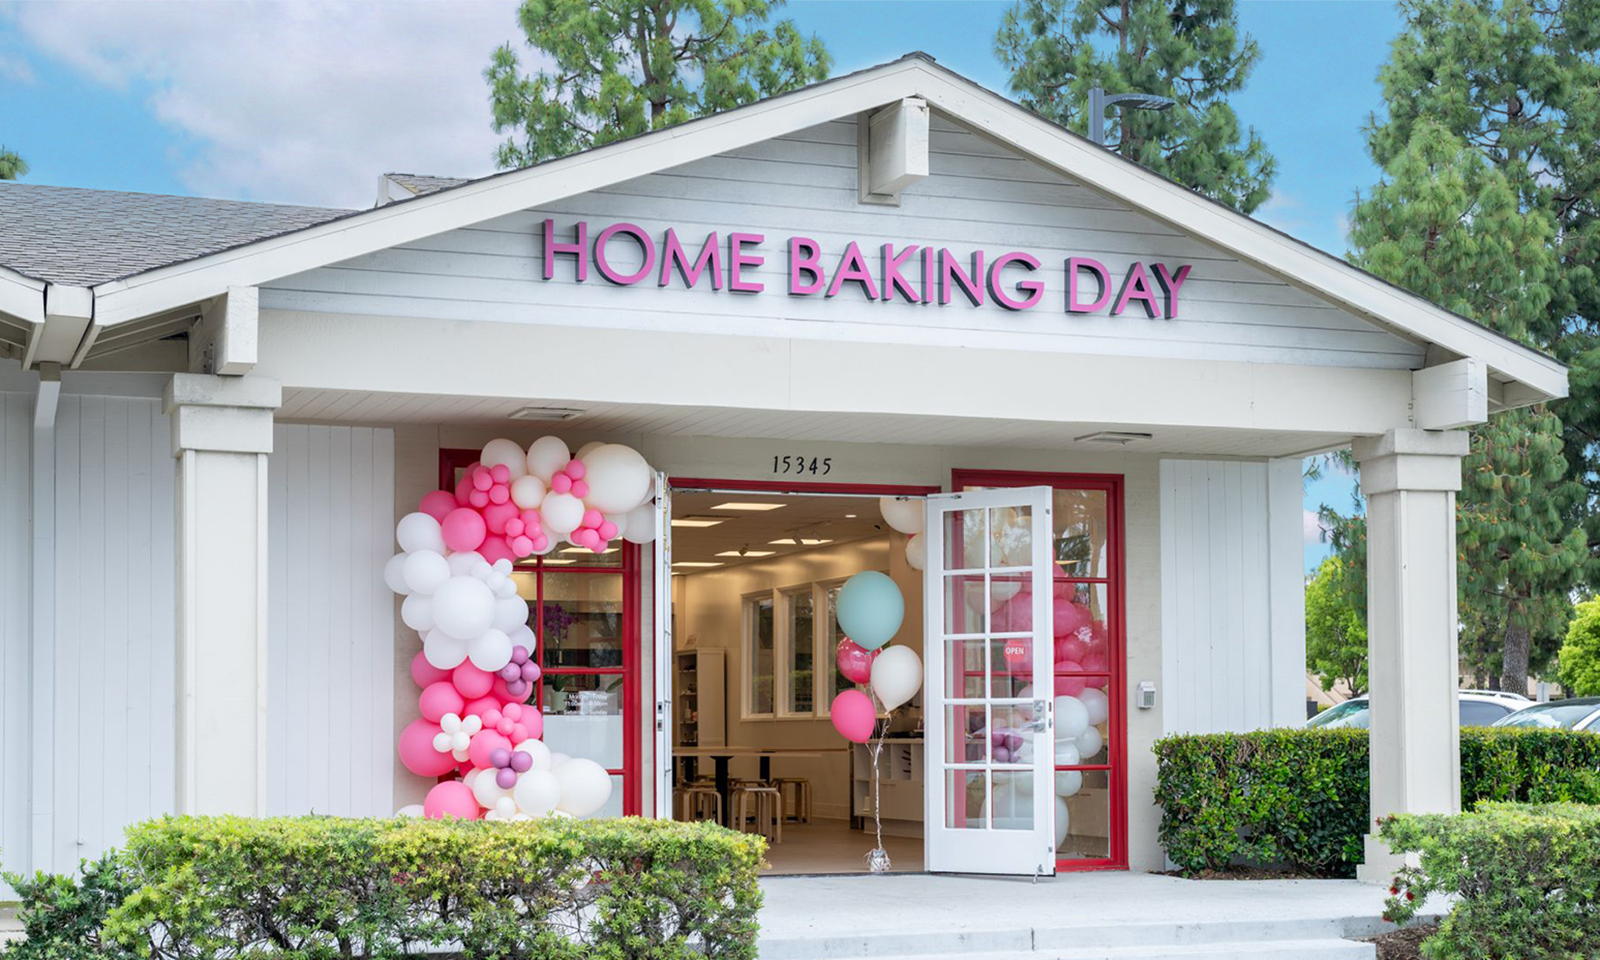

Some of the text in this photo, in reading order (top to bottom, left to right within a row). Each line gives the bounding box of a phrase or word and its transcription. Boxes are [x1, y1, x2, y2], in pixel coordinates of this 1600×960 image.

[542, 218, 1192, 320] HOME BAKING DAY
[773, 456, 832, 475] 15345
[1005, 647, 1024, 655] OPEN
